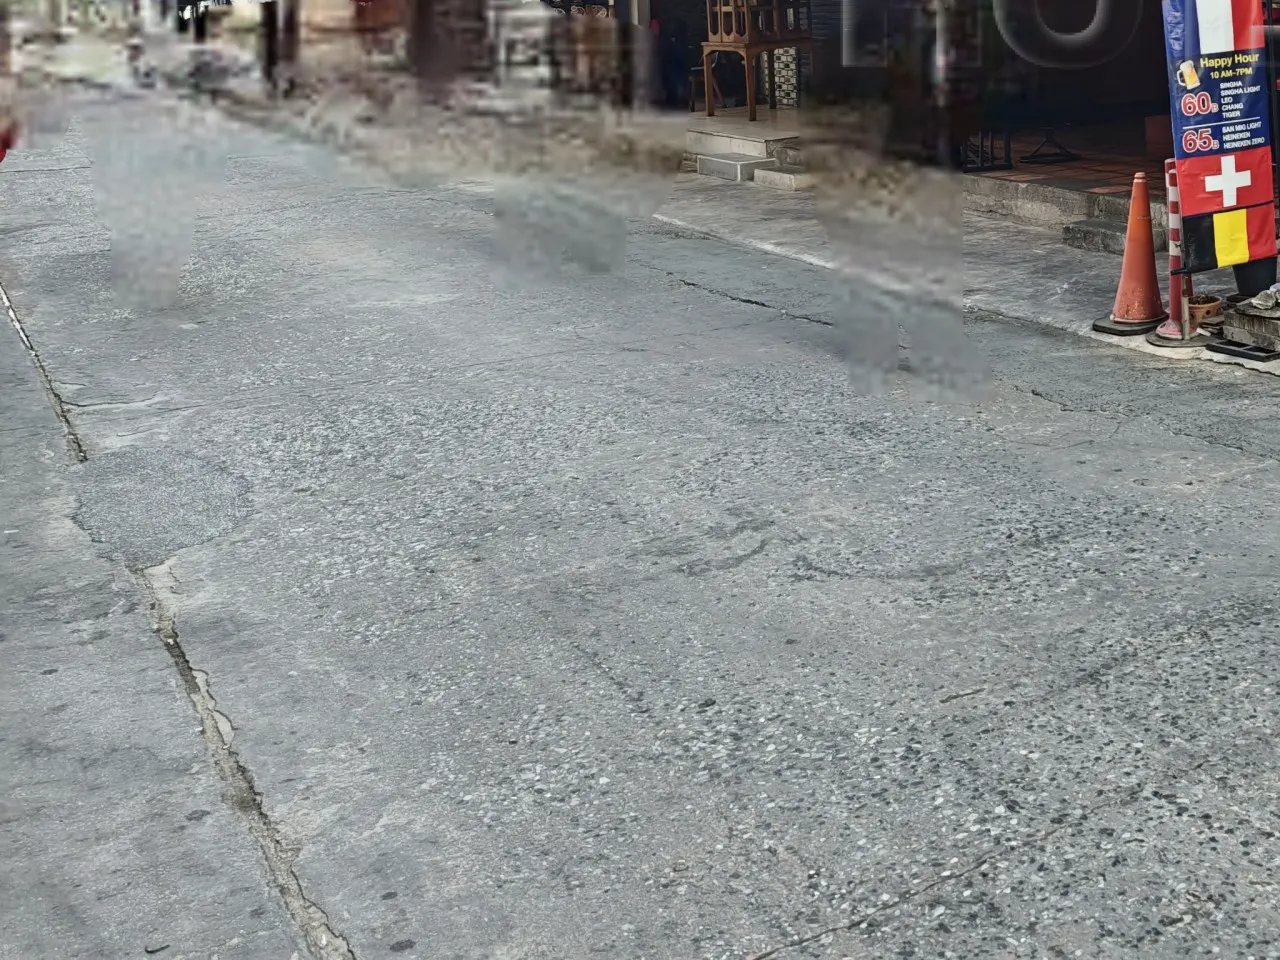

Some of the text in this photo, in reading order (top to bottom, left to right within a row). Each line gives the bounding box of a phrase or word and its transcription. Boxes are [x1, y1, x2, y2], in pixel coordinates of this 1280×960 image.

[1200, 54, 1259, 68] Happy Hour
[1210, 71, 1219, 79] 10
[1220, 81, 1242, 89] SINGHA
[1221, 85, 1261, 96] SINGHA LIGHT
[1222, 103, 1244, 111] CHANG
[1247, 121, 1262, 129] LIGHT
[1223, 132, 1251, 141] HEINEKEN
[1224, 137, 1265, 149] HEINEKEN ZERO
